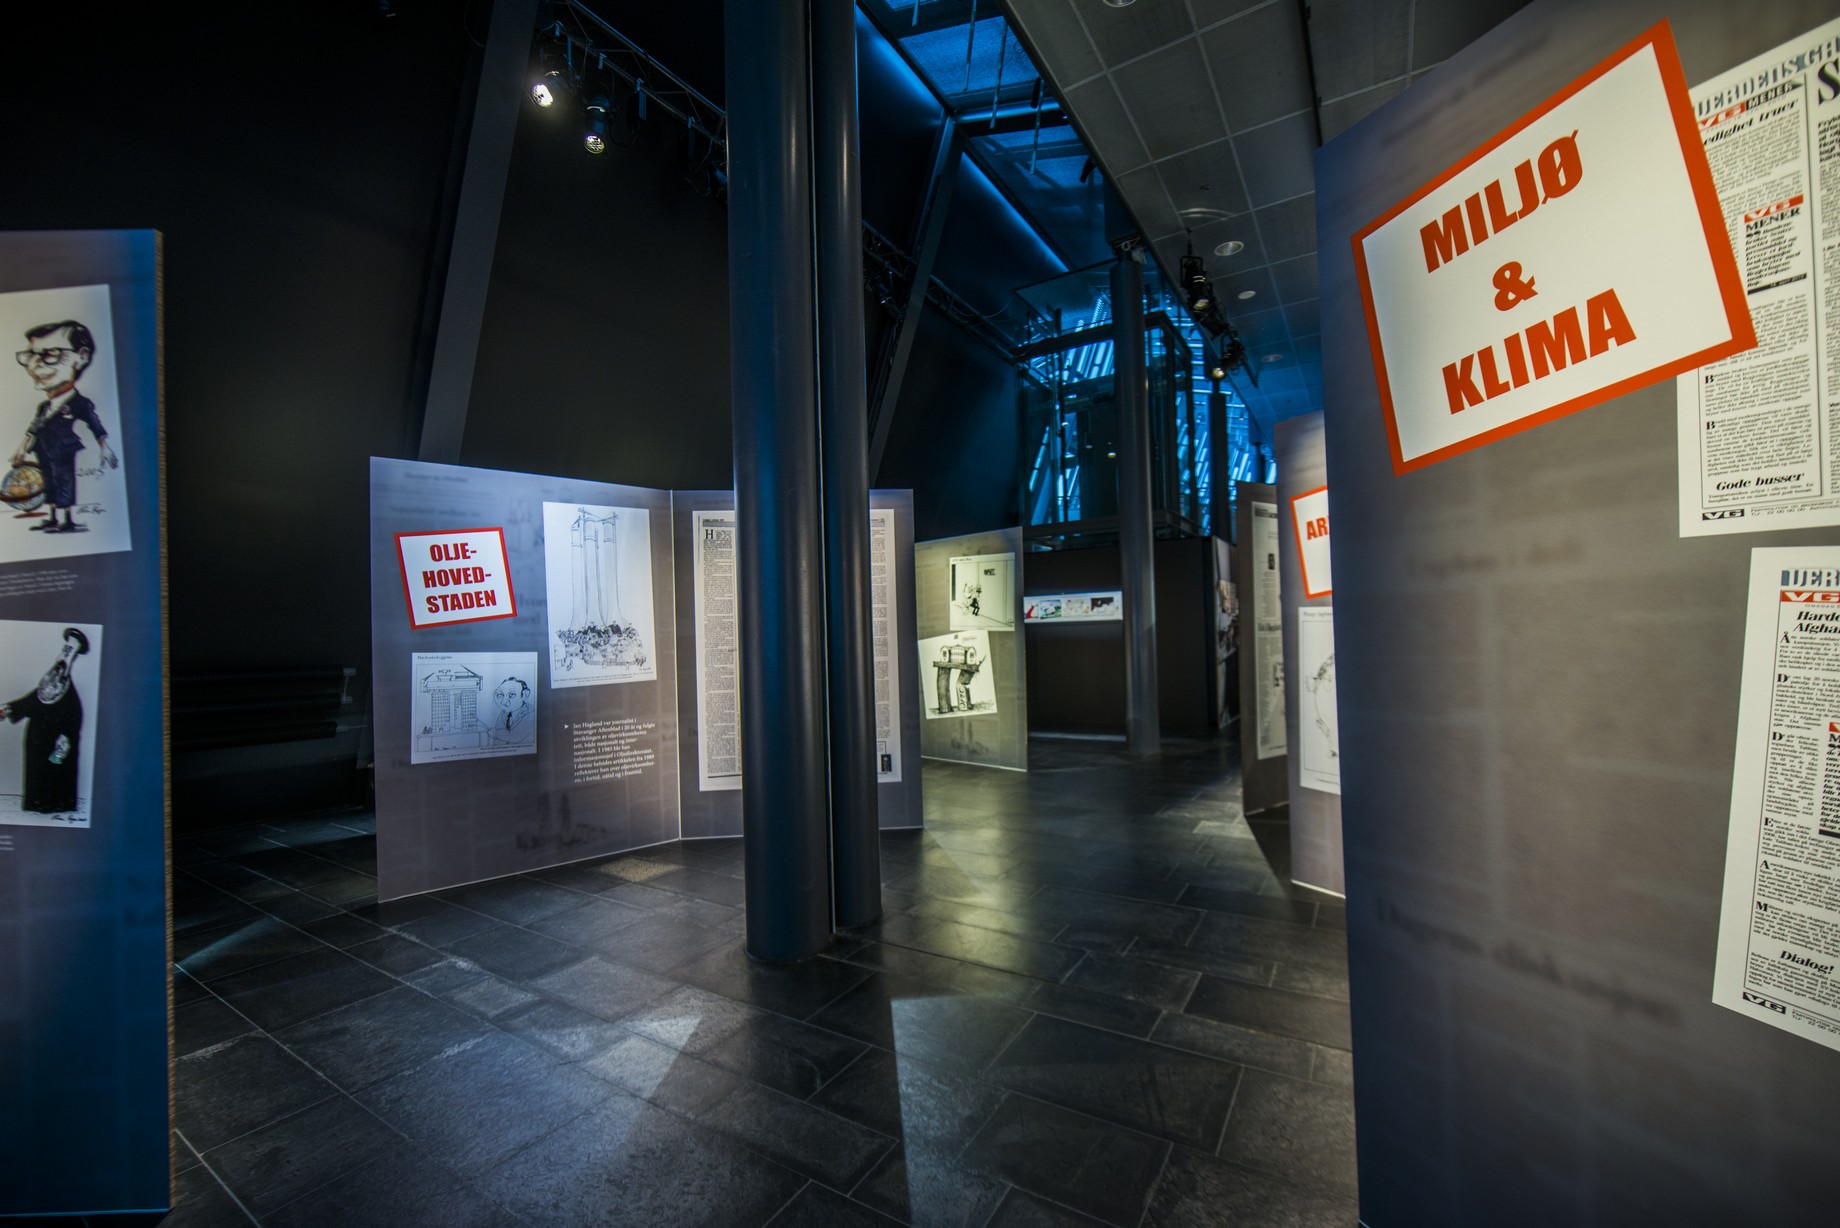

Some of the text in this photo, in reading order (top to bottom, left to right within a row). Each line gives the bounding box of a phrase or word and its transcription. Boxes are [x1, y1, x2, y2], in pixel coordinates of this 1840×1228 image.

[1746, 80, 1793, 112] MENER
[1703, 117, 1753, 146] edighet
[1759, 99, 1798, 122] truer
[1420, 130, 1582, 273] MILJØ
[1746, 207, 1800, 232] MENER
[1492, 261, 1538, 311] &
[1442, 288, 1636, 415] KLIMA
[1716, 472, 1805, 491] Gode busser
[1702, 509, 1745, 520] VG
[1306, 516, 1329, 540] AR
[430, 543, 477, 562] OLJE-
[422, 566, 492, 588] HOVED-
[426, 590, 497, 613] STADEN
[1783, 591, 1839, 602] VG
[1780, 949, 1835, 976] Dialog!
